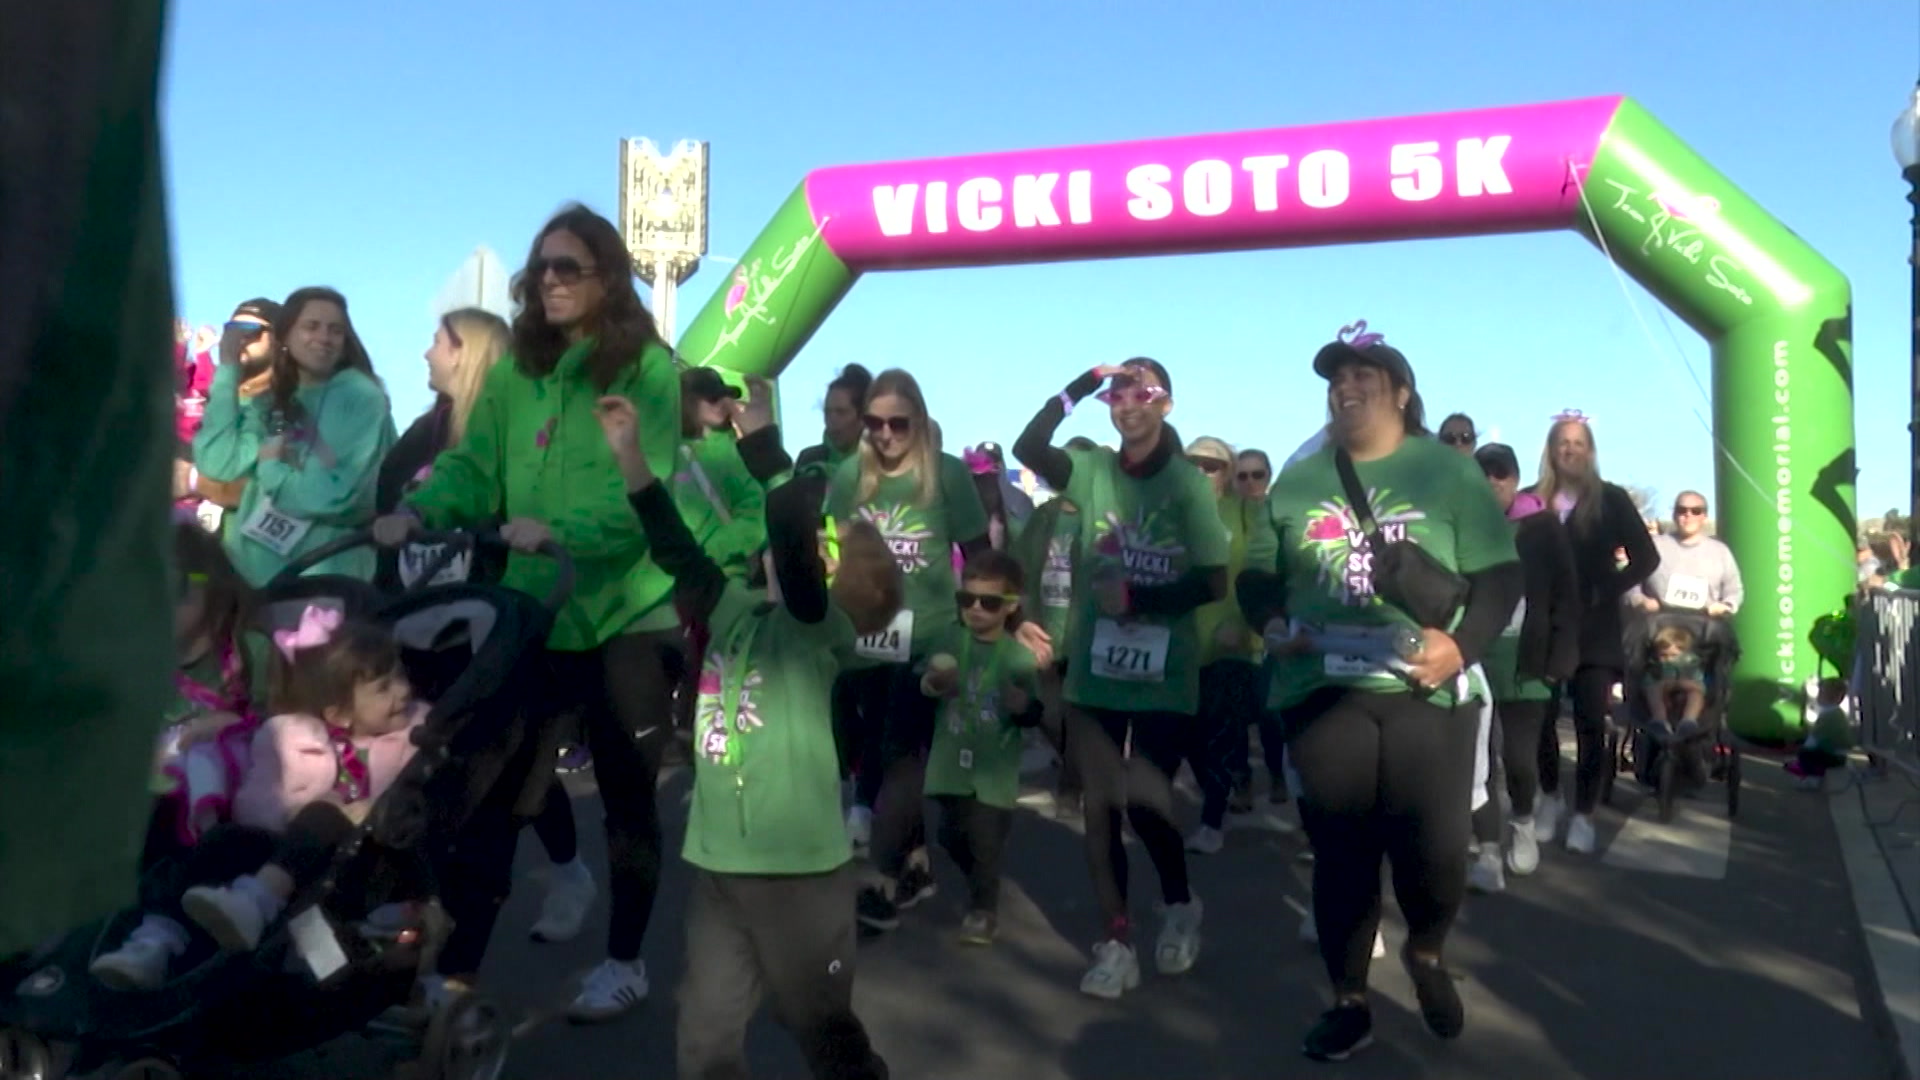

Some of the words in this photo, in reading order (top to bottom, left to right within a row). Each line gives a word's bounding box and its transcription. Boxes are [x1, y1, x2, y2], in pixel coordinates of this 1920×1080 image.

[871, 170, 1092, 237] VICKI
[1126, 149, 1350, 221] SOTO
[1390, 134, 1513, 202] 5K
[1121, 548, 1170, 575] VICKI
[1105, 644, 1152, 672] 1271
